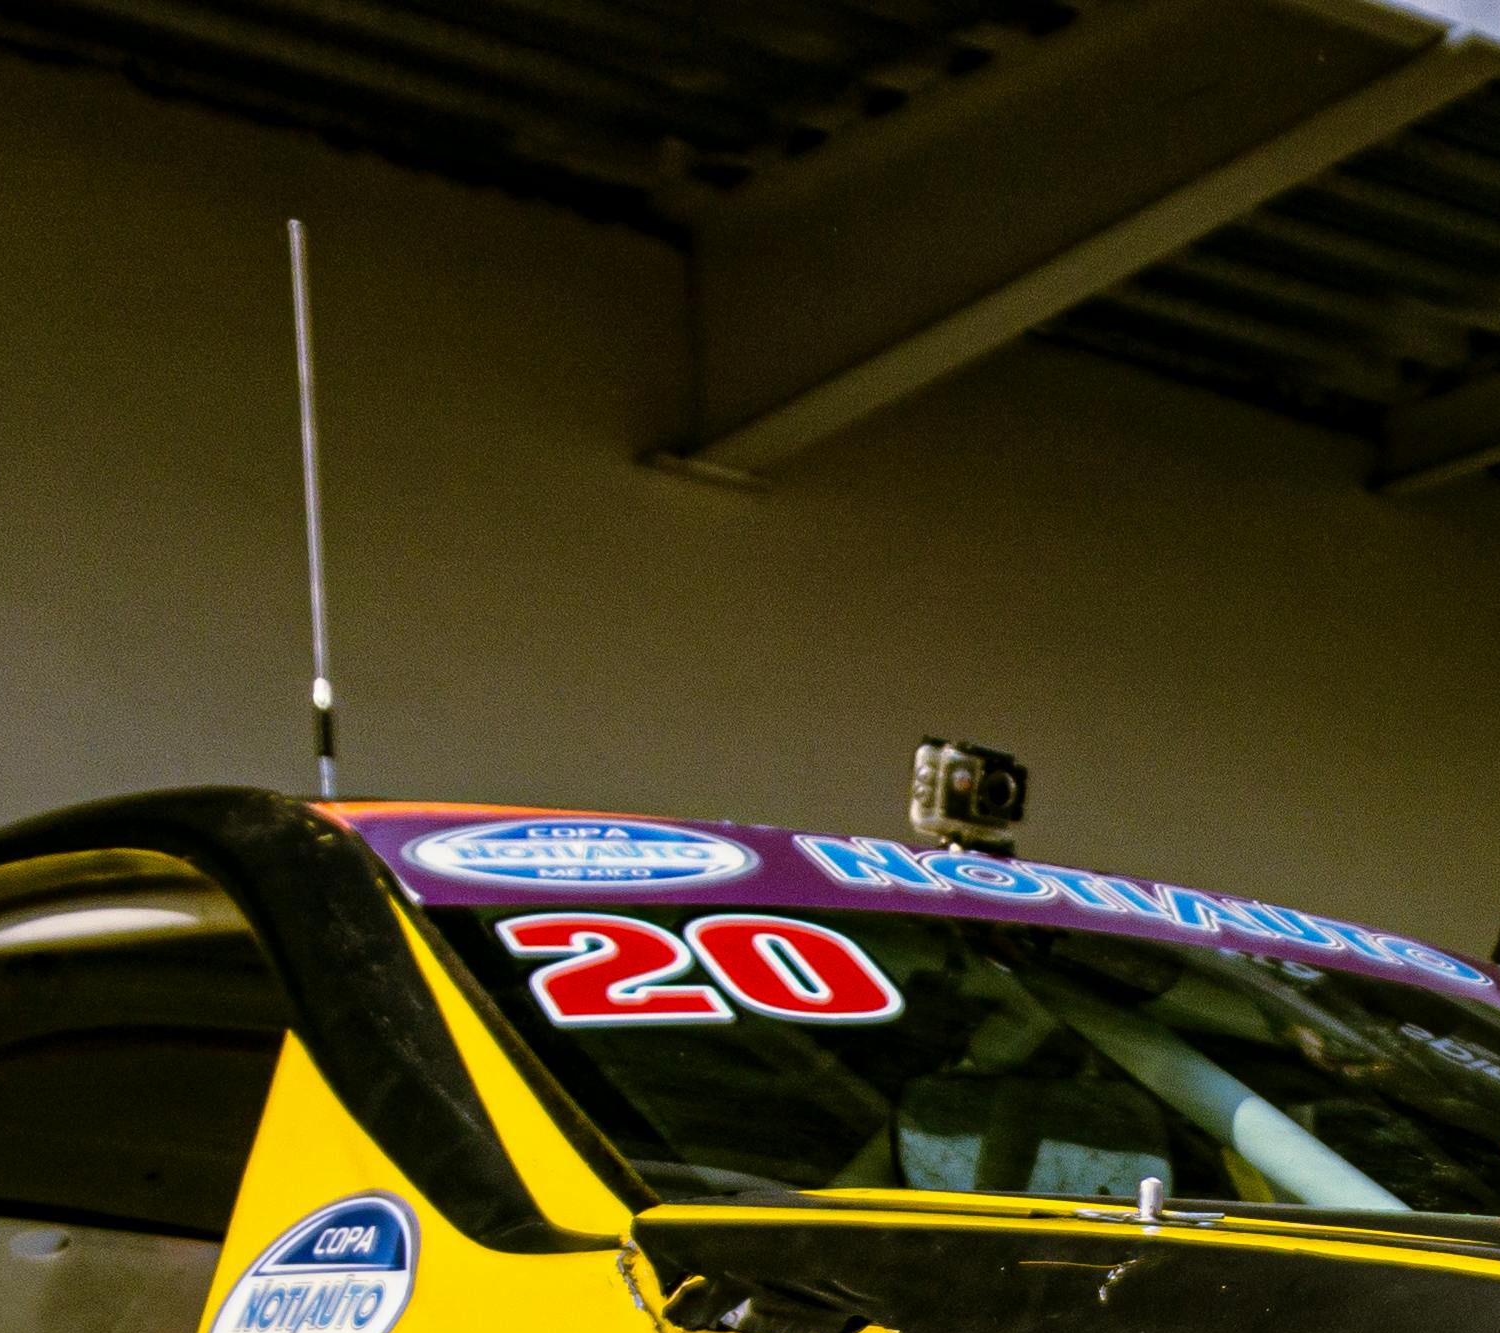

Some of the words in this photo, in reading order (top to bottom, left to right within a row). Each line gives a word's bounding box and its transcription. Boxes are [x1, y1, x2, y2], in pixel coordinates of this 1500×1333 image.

[526, 826, 630, 839] COPA
[454, 840, 712, 864] NOTIAUTO
[794, 833, 1496, 988] NOTIAUTO
[495, 911, 905, 1028] 20
[312, 1224, 376, 1256] COPA
